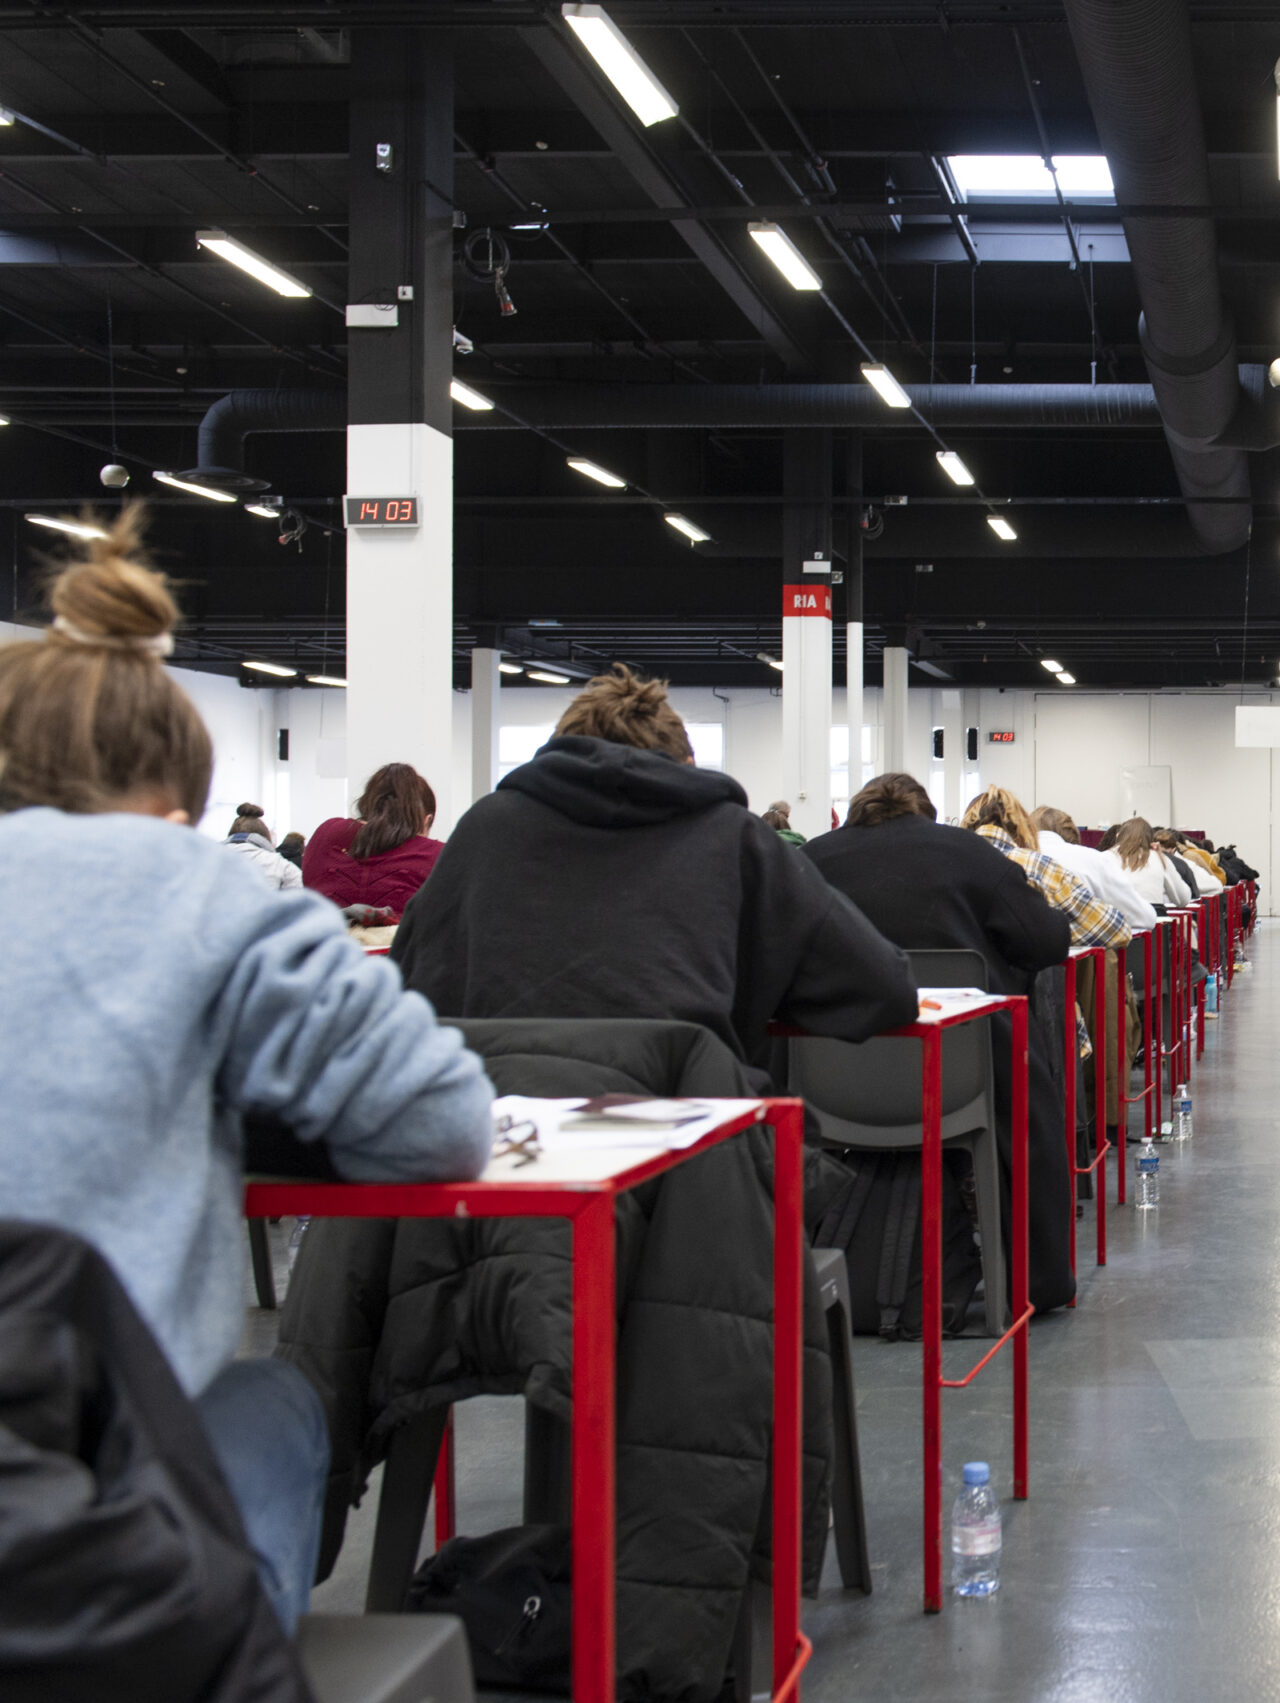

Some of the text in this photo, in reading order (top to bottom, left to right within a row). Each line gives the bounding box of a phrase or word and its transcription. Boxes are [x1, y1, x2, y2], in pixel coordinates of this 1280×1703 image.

[360, 501, 413, 521] 14 03
[793, 594, 817, 609] RIA
